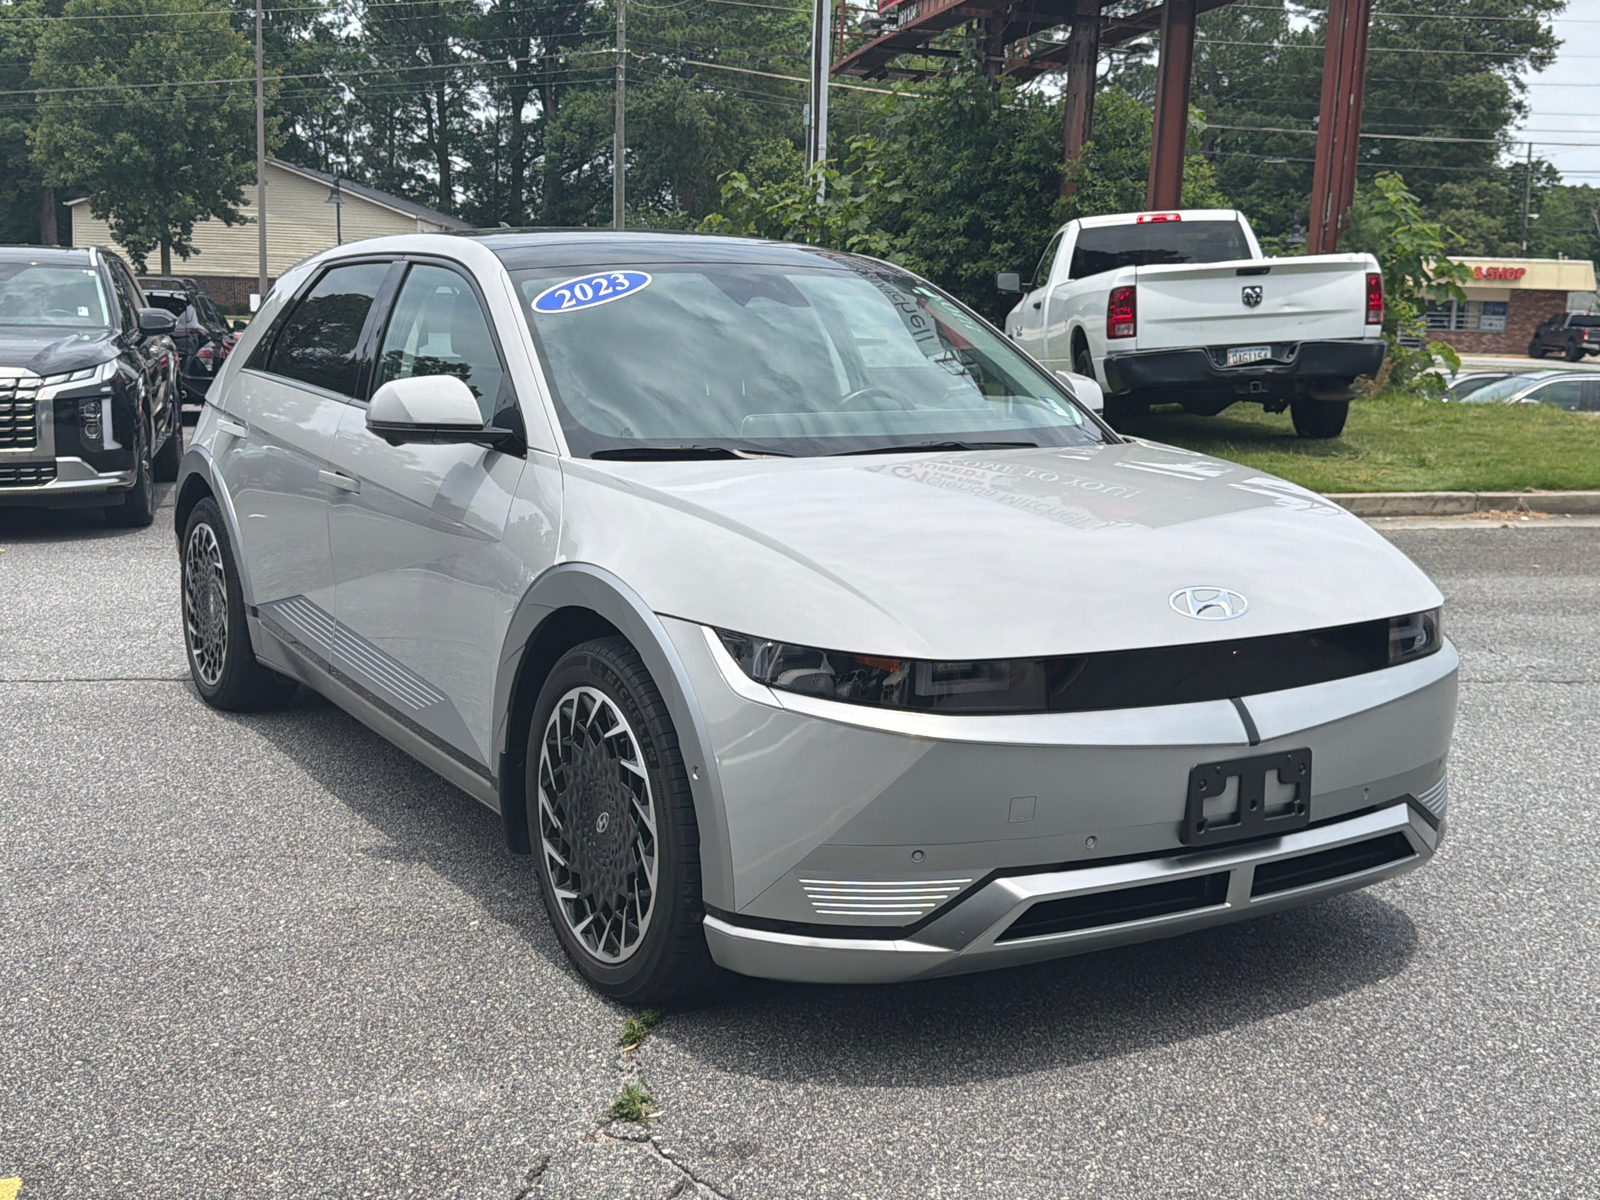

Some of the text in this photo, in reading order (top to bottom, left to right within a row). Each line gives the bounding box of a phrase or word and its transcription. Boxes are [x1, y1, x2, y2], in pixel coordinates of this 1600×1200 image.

[555, 273, 630, 309] 2023
[1486, 266, 1526, 280] SHOP
[604, 669, 657, 762] MICHELIN
